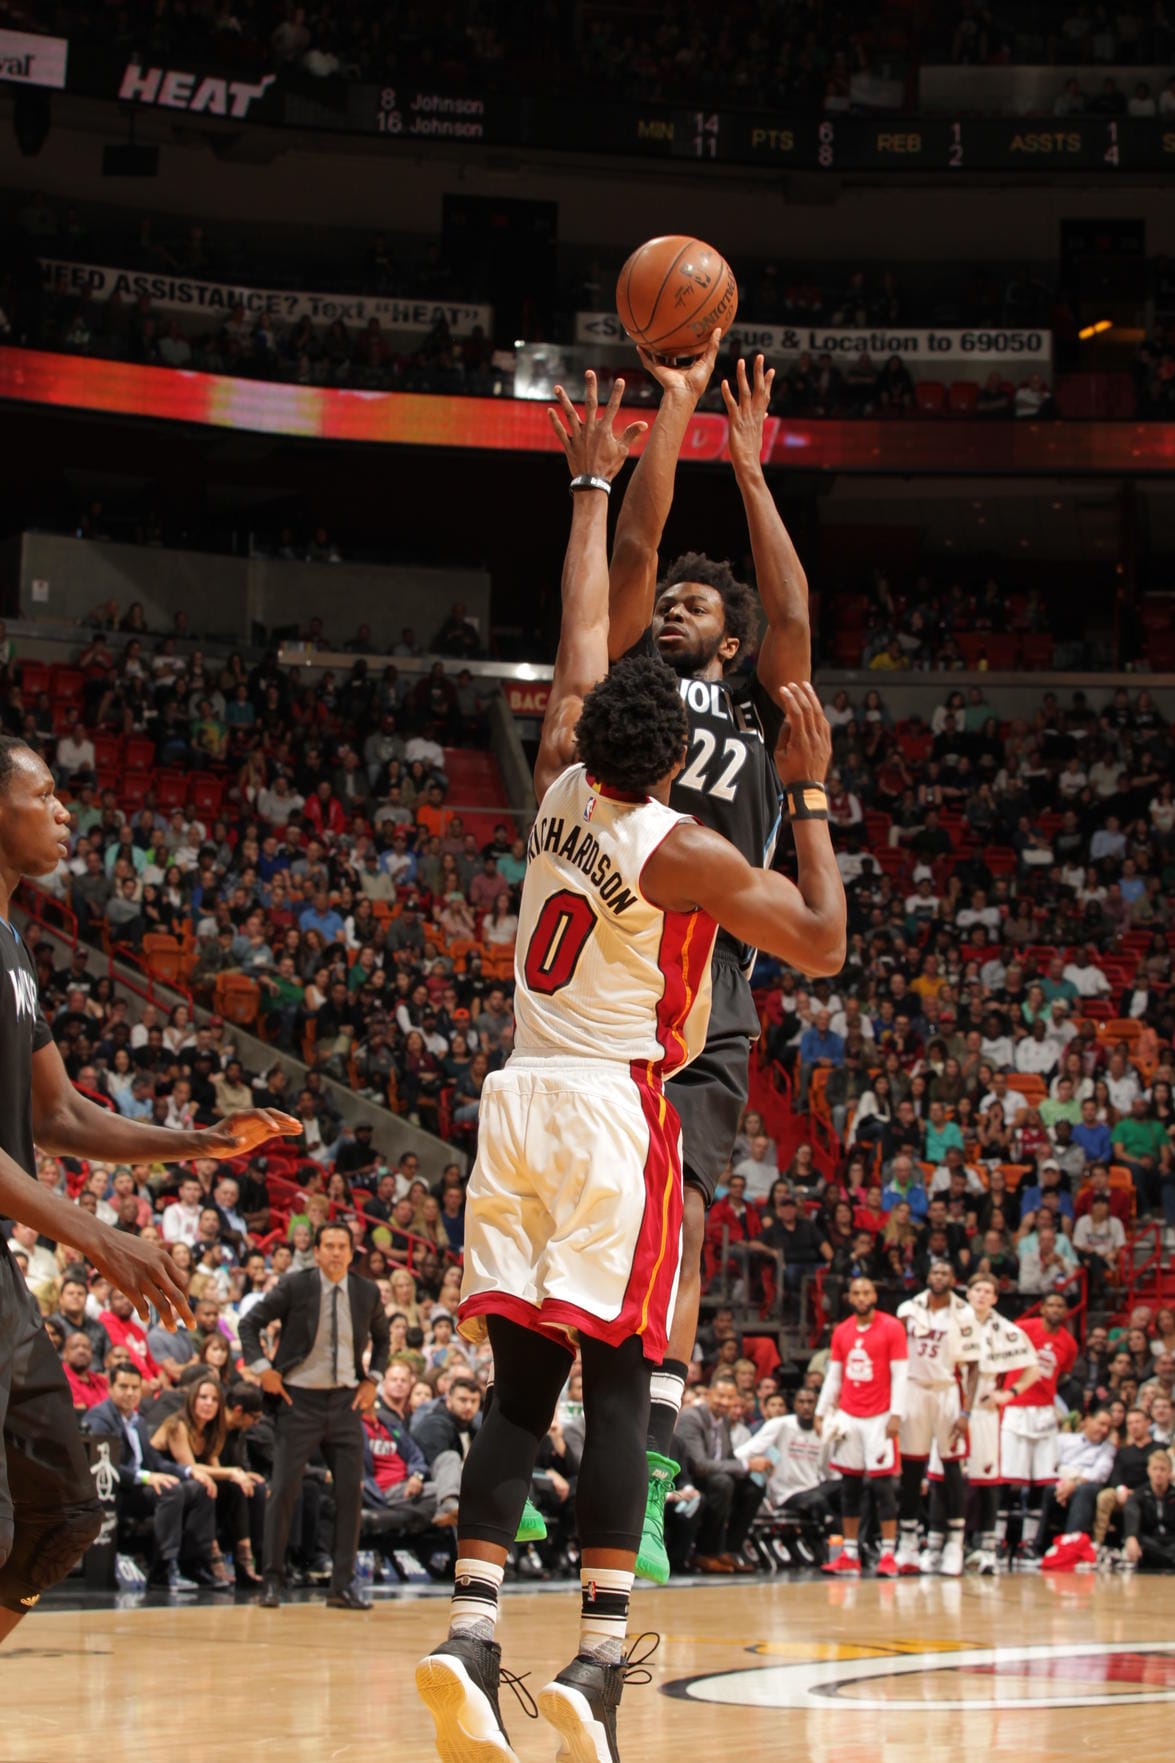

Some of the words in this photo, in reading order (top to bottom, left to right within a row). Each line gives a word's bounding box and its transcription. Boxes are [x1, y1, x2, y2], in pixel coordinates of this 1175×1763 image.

[117, 63, 277, 120] HEAT
[380, 87, 397, 110] 8
[409, 93, 485, 116] Johnson
[377, 109, 402, 134] 16
[409, 117, 484, 138] Johnson
[637, 120, 674, 141] MIN
[696, 111, 720, 134] 14
[752, 129, 795, 151] PTS
[818, 120, 834, 144] 6
[875, 132, 922, 152] REB
[951, 122, 961, 144] 1
[1009, 131, 1081, 152] ASSTS
[1108, 121, 1118, 143] 1
[694, 136, 717, 159] 11
[818, 145, 834, 168] 8
[948, 145, 963, 166] 2
[1103, 144, 1119, 167] 4
[114, 274, 298, 314] ASSISTANCE?
[308, 297, 364, 319] Text
[781, 329, 800, 349] &
[810, 331, 918, 352] Location
[928, 333, 951, 352] to
[961, 332, 1042, 352] 69050
[679, 728, 747, 802] 22
[524, 888, 598, 996] 0
[917, 1343, 940, 1358] 35
